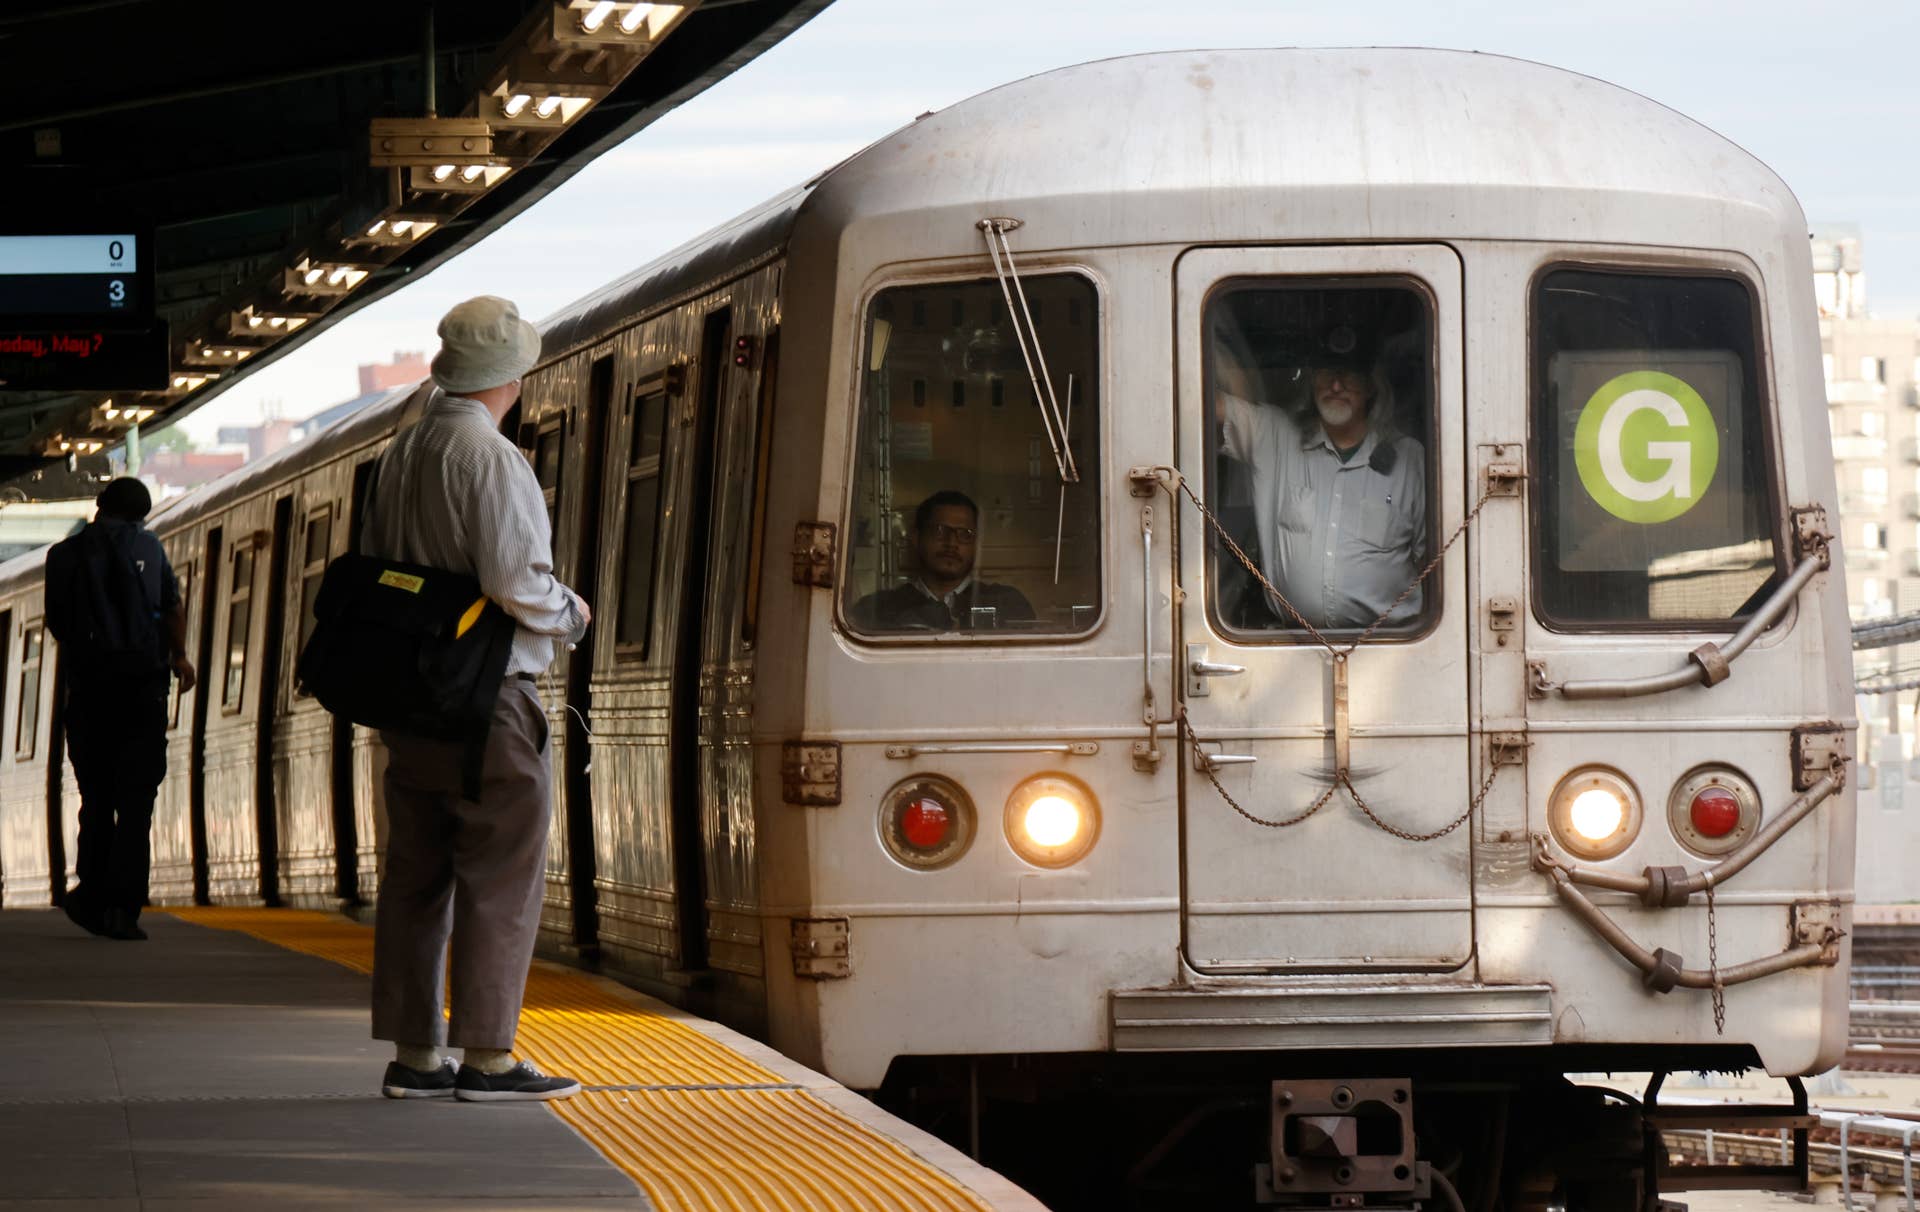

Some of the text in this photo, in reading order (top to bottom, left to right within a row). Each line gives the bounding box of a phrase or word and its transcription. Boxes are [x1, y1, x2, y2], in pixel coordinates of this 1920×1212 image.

[109, 241, 124, 260] 0
[109, 280, 125, 301] 3
[53, 335, 90, 357] May
[1599, 389, 1691, 502] G
